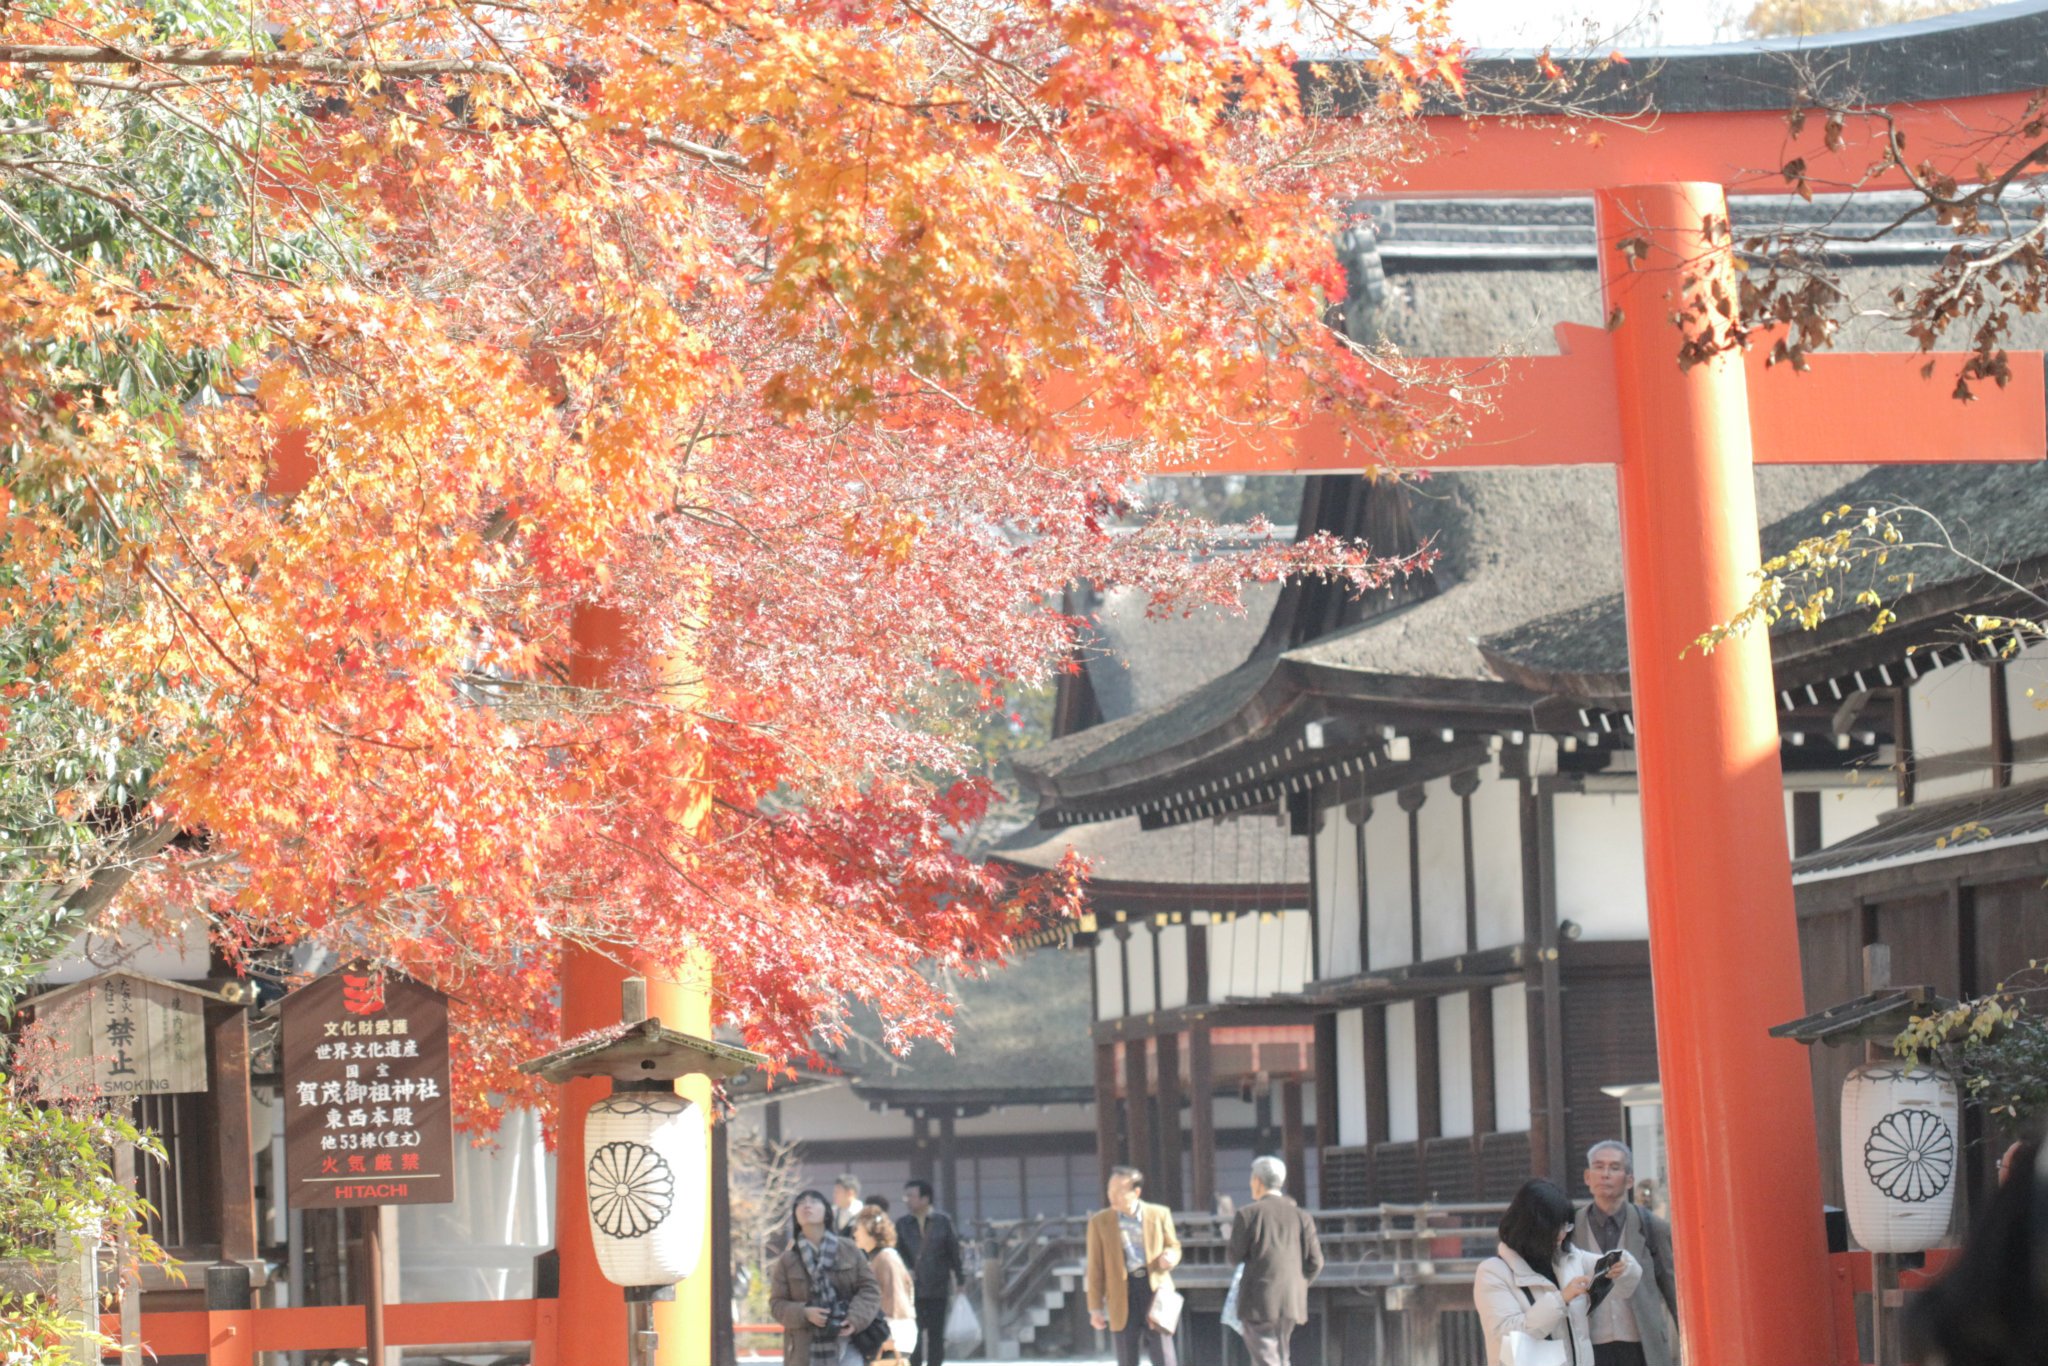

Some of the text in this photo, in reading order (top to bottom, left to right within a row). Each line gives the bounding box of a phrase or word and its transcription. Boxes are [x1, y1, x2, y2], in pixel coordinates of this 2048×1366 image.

[323, 1019, 409, 1037] 文化財愛護
[105, 1016, 136, 1076] 禁止
[314, 1038, 420, 1061] 世界文化遺産
[345, 1062, 391, 1079] 国宝
[103, 1078, 170, 1093] SMOKING
[295, 1077, 441, 1108] 賀茂御祖神社
[323, 1106, 414, 1130] 東西本殿
[321, 1152, 421, 1174] 火気厳禁
[334, 1183, 409, 1199] HITACHI
